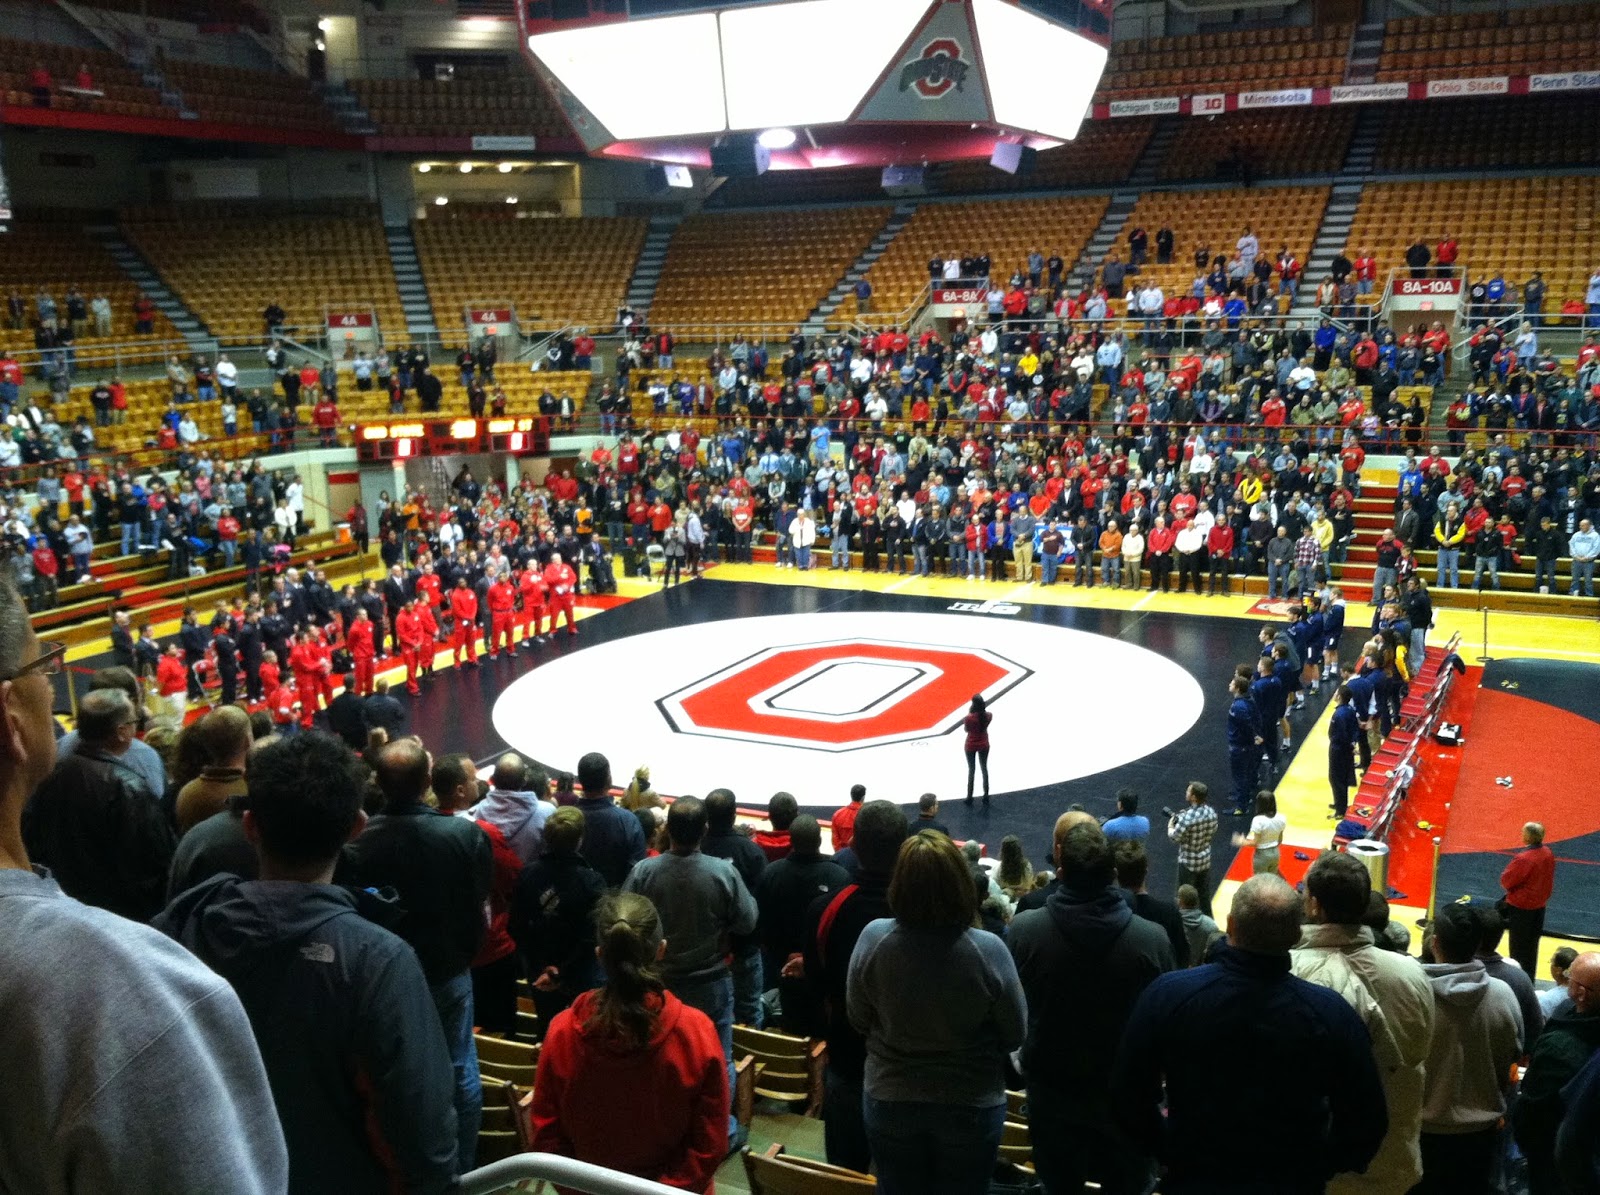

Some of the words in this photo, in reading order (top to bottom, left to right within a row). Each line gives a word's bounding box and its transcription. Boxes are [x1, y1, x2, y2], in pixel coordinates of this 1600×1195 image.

[1432, 82, 1461, 94] Ohio
[1467, 80, 1504, 91] State
[1532, 77, 1567, 88] Penn
[1244, 92, 1307, 104] Minnesota
[1332, 86, 1407, 100] Northwestern
[1111, 103, 1151, 115] Michigan
[1153, 101, 1177, 111] State
[1402, 281, 1454, 293] 8A-10A
[942, 291, 978, 301] 6A-8A
[341, 316, 358, 326] 4A
[481, 312, 497, 322] 4A
